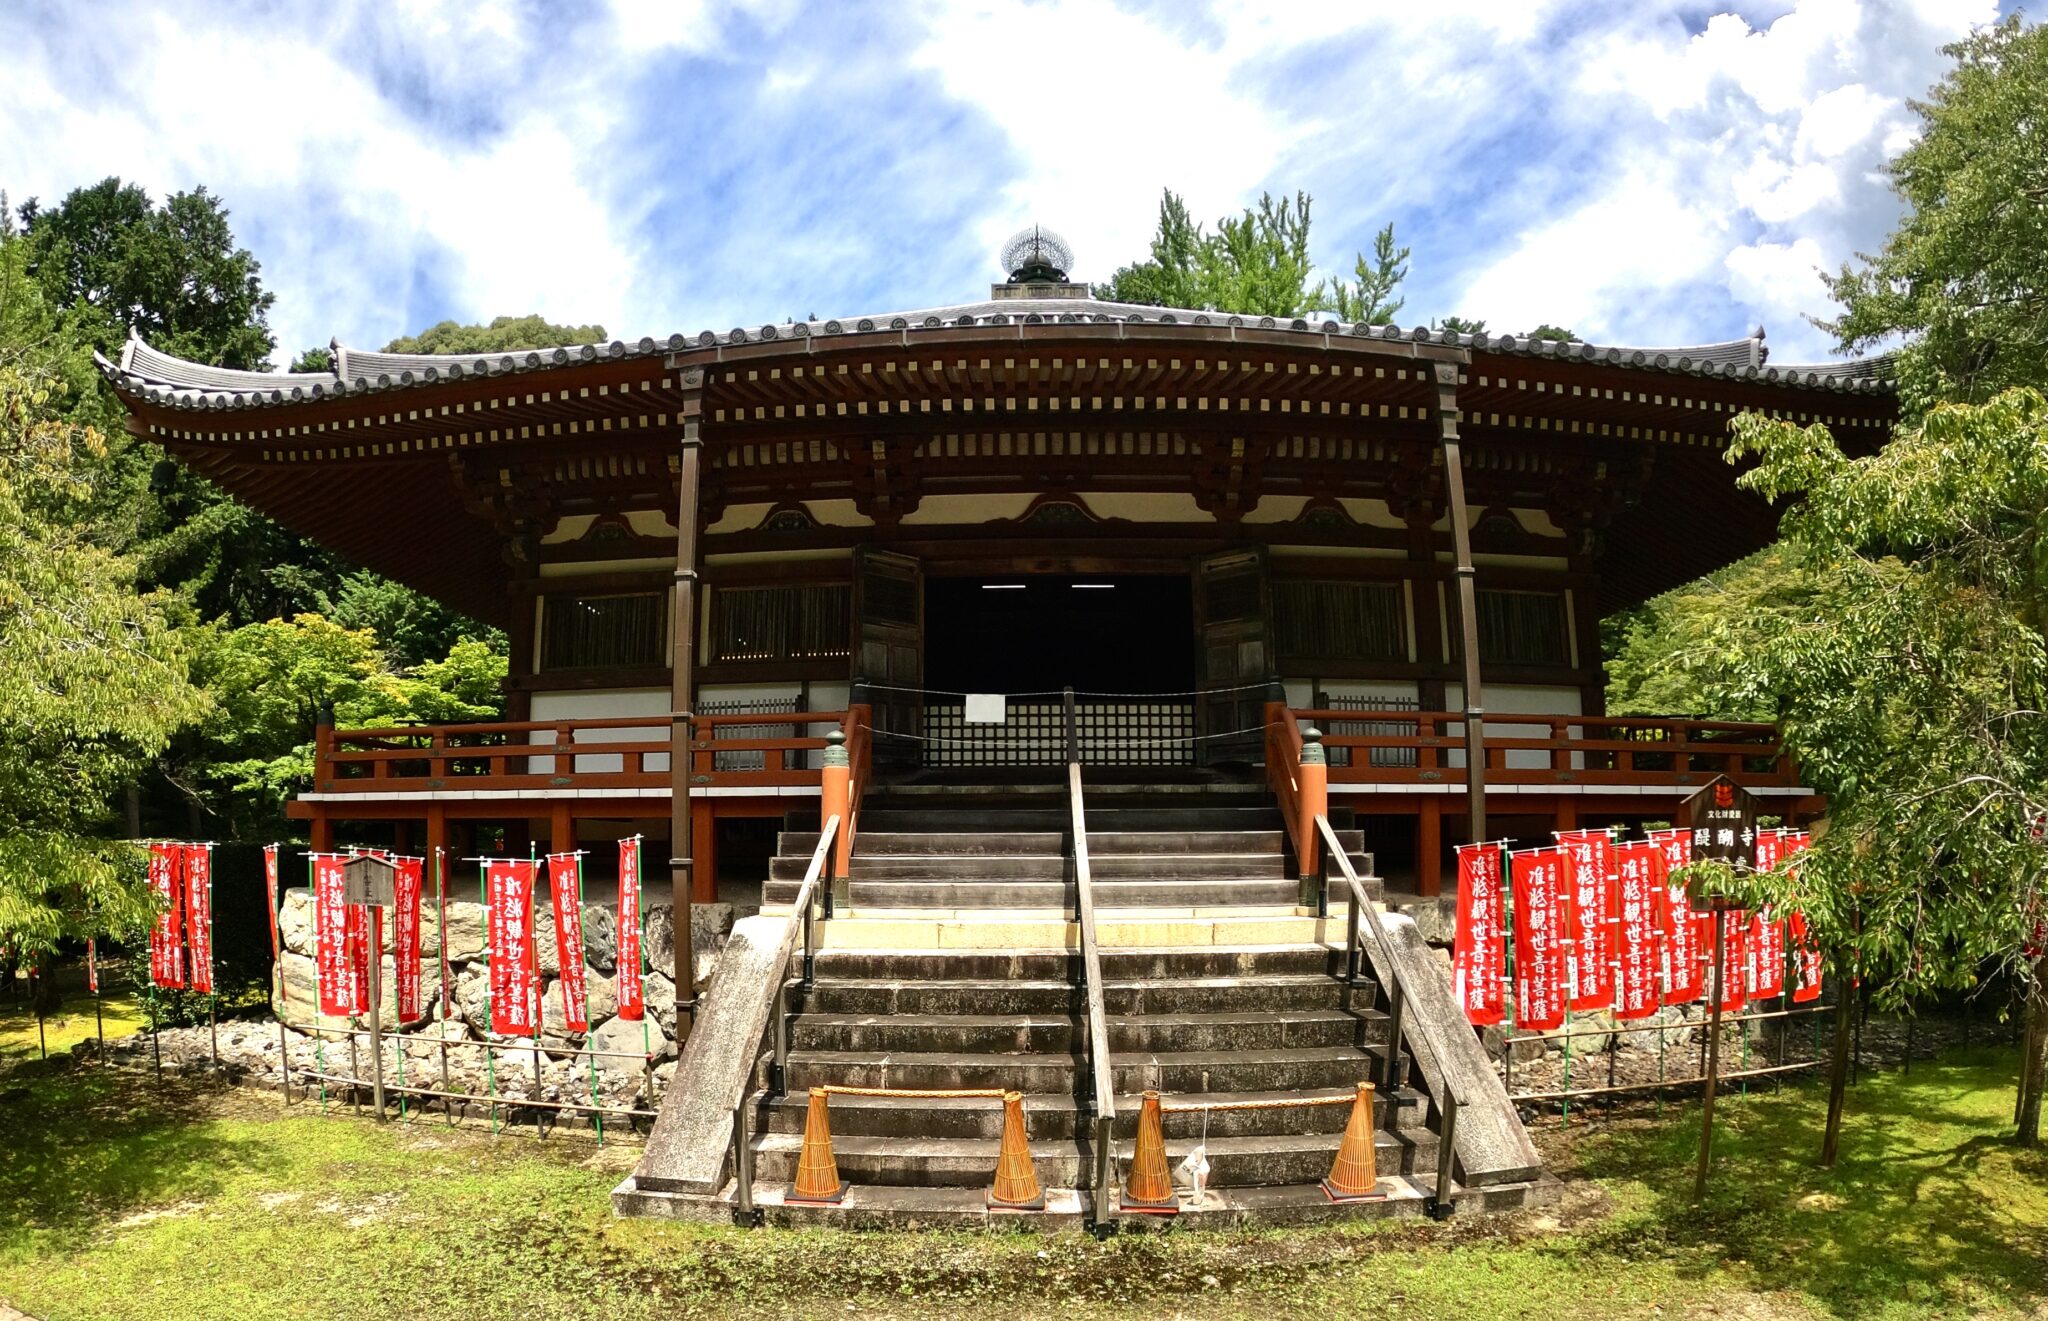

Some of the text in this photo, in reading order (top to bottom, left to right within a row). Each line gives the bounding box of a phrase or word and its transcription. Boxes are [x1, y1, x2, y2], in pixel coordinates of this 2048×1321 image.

[1695, 827, 1754, 847] 醍醐寺
[1470, 856, 1489, 1010] 准胝観世音菩薩
[1528, 866, 1549, 1020] 准胝観世音菩薩
[1575, 843, 1598, 996] 准胝観世音菩薩
[1622, 859, 1644, 1010] 准胝観世音菩薩
